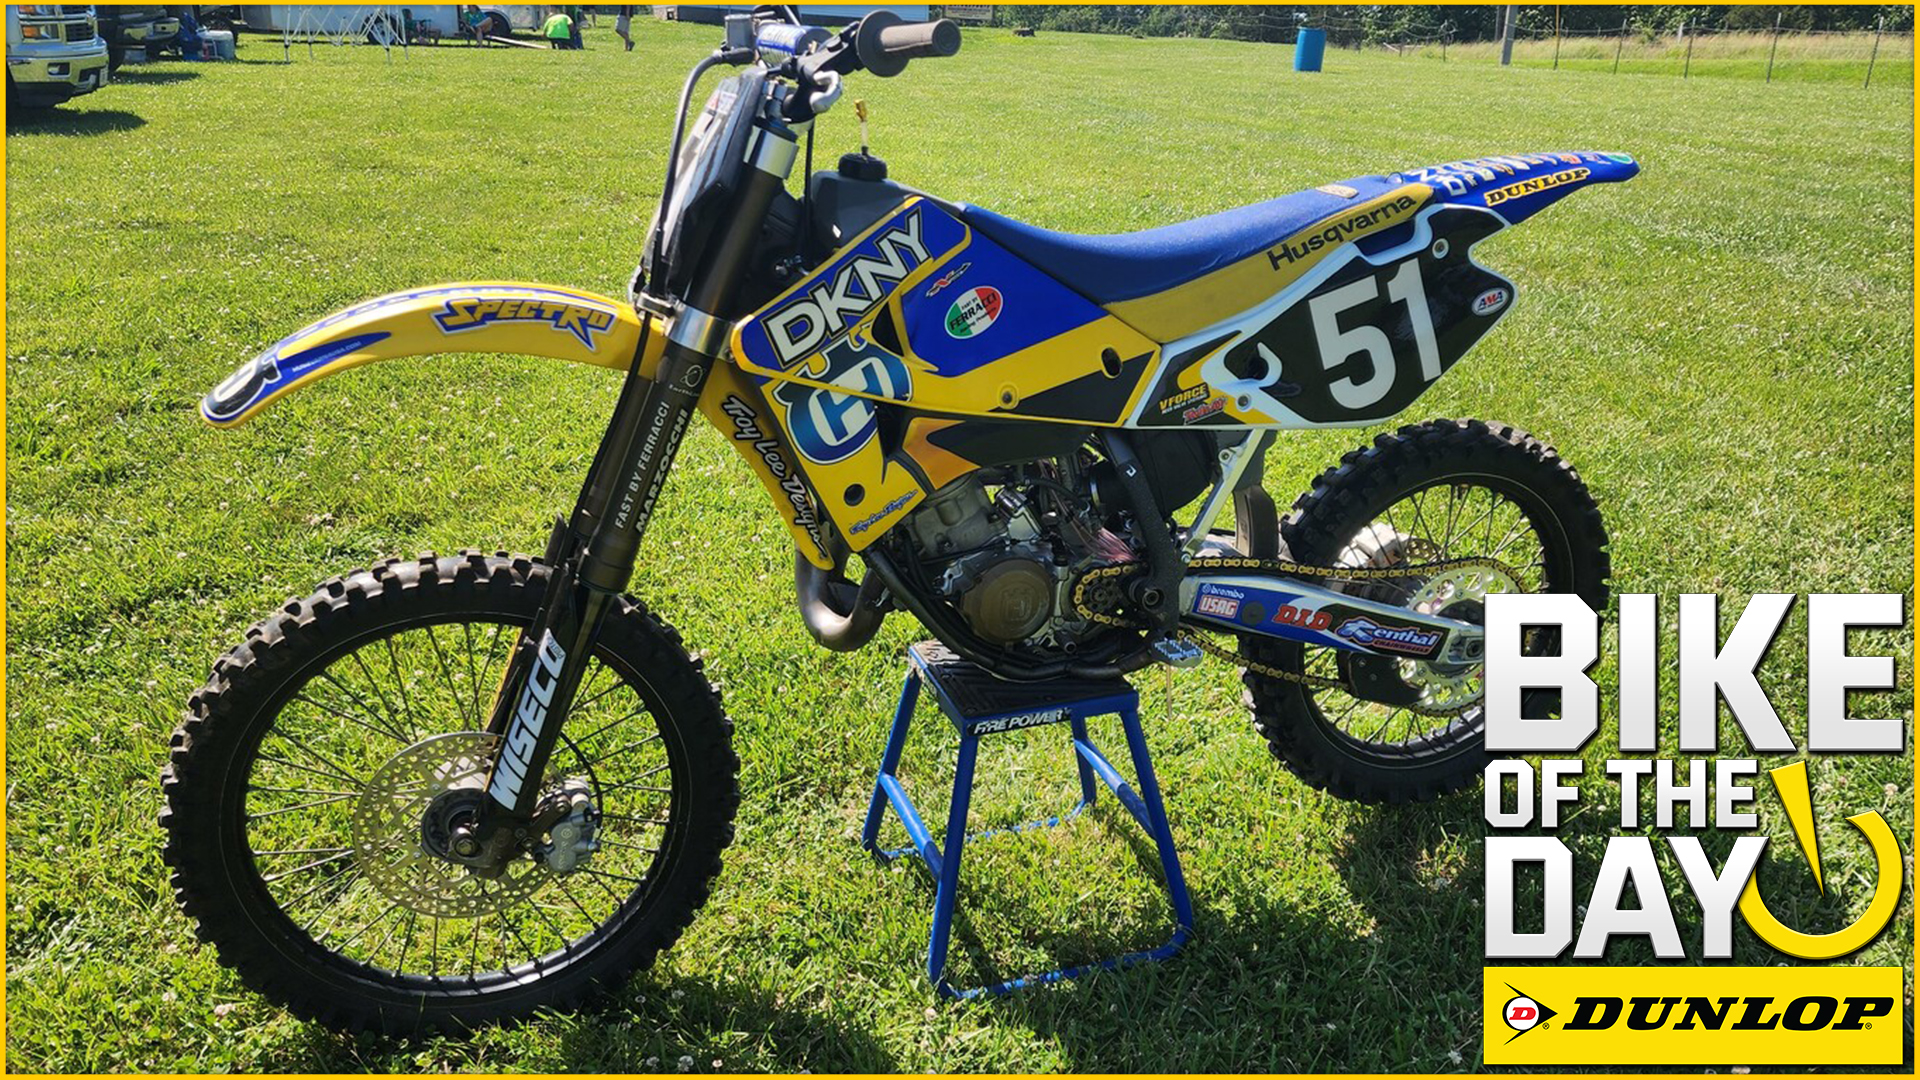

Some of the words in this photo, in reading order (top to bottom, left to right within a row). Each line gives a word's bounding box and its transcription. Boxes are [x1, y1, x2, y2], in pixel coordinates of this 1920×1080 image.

[1485, 168, 1590, 205] DUNLOP
[1266, 193, 1416, 271] Husqvarna
[763, 209, 931, 367] DKNY
[949, 292, 998, 331] FERRACCI
[431, 297, 617, 351] SPECTRO
[1308, 258, 1442, 410] 51
[1159, 384, 1207, 410] VFORCE
[615, 493, 635, 529] FAST
[629, 471, 643, 493] BY
[637, 401, 670, 471] FERRACCI
[635, 408, 689, 533] MARZOCCHI
[722, 395, 762, 441] Troy
[754, 440, 787, 479] Lee
[780, 473, 828, 558] Designs
[1199, 597, 1238, 616] USAG
[1337, 617, 1440, 647] Renthal
[489, 627, 566, 811] WISECO
[973, 717, 1009, 735] FIRE
[1008, 708, 1063, 729] POWER
